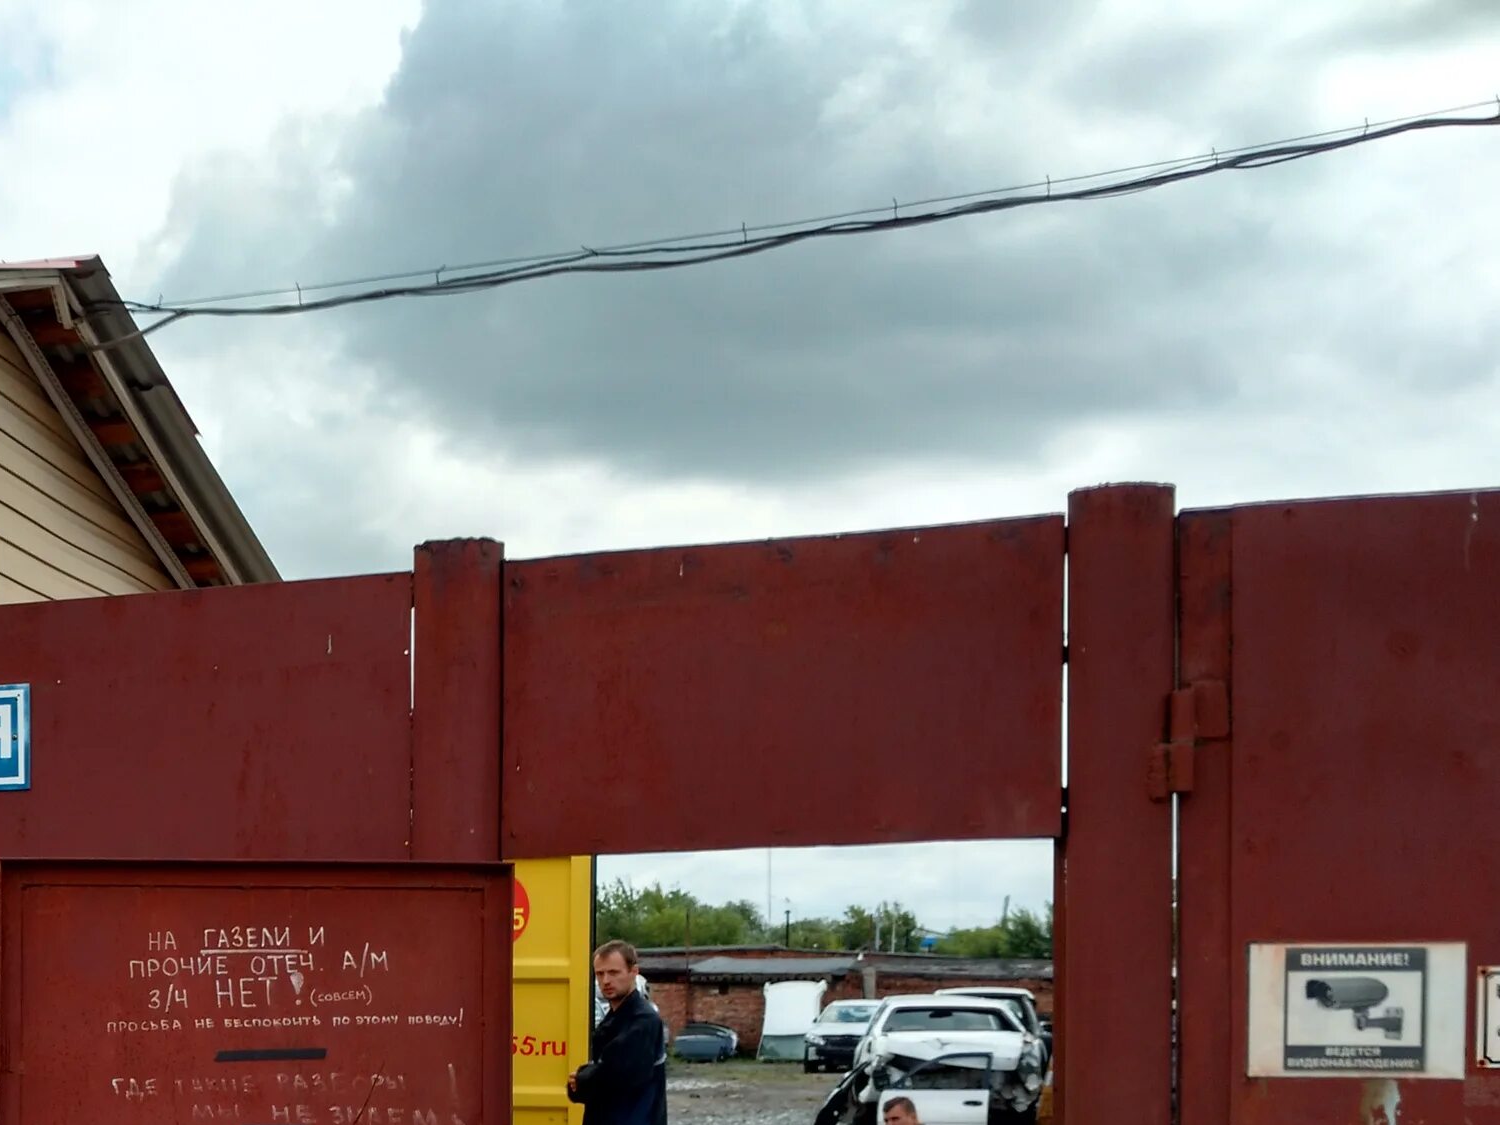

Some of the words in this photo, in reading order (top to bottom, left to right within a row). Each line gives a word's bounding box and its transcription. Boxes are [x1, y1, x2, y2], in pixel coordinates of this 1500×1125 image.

[149, 931, 177, 950] НА
[204, 926, 290, 948] ГАЗЕЛИ
[309, 926, 325, 947] И
[129, 956, 228, 979] ПРОЧИЕ
[251, 953, 324, 975] ОТЕЧ.
[342, 942, 389, 978] А/М
[1300, 952, 1409, 967] ВНИМАНИЕ!
[107, 1018, 182, 1033] ПРОСЬБА
[195, 1018, 214, 1029] НЕ
[332, 1015, 350, 1027] ПО
[355, 1014, 398, 1025] ЭТОМУ
[408, 1007, 464, 1028] ПОВОДУ!
[111, 1077, 158, 1101] ГДЕ
